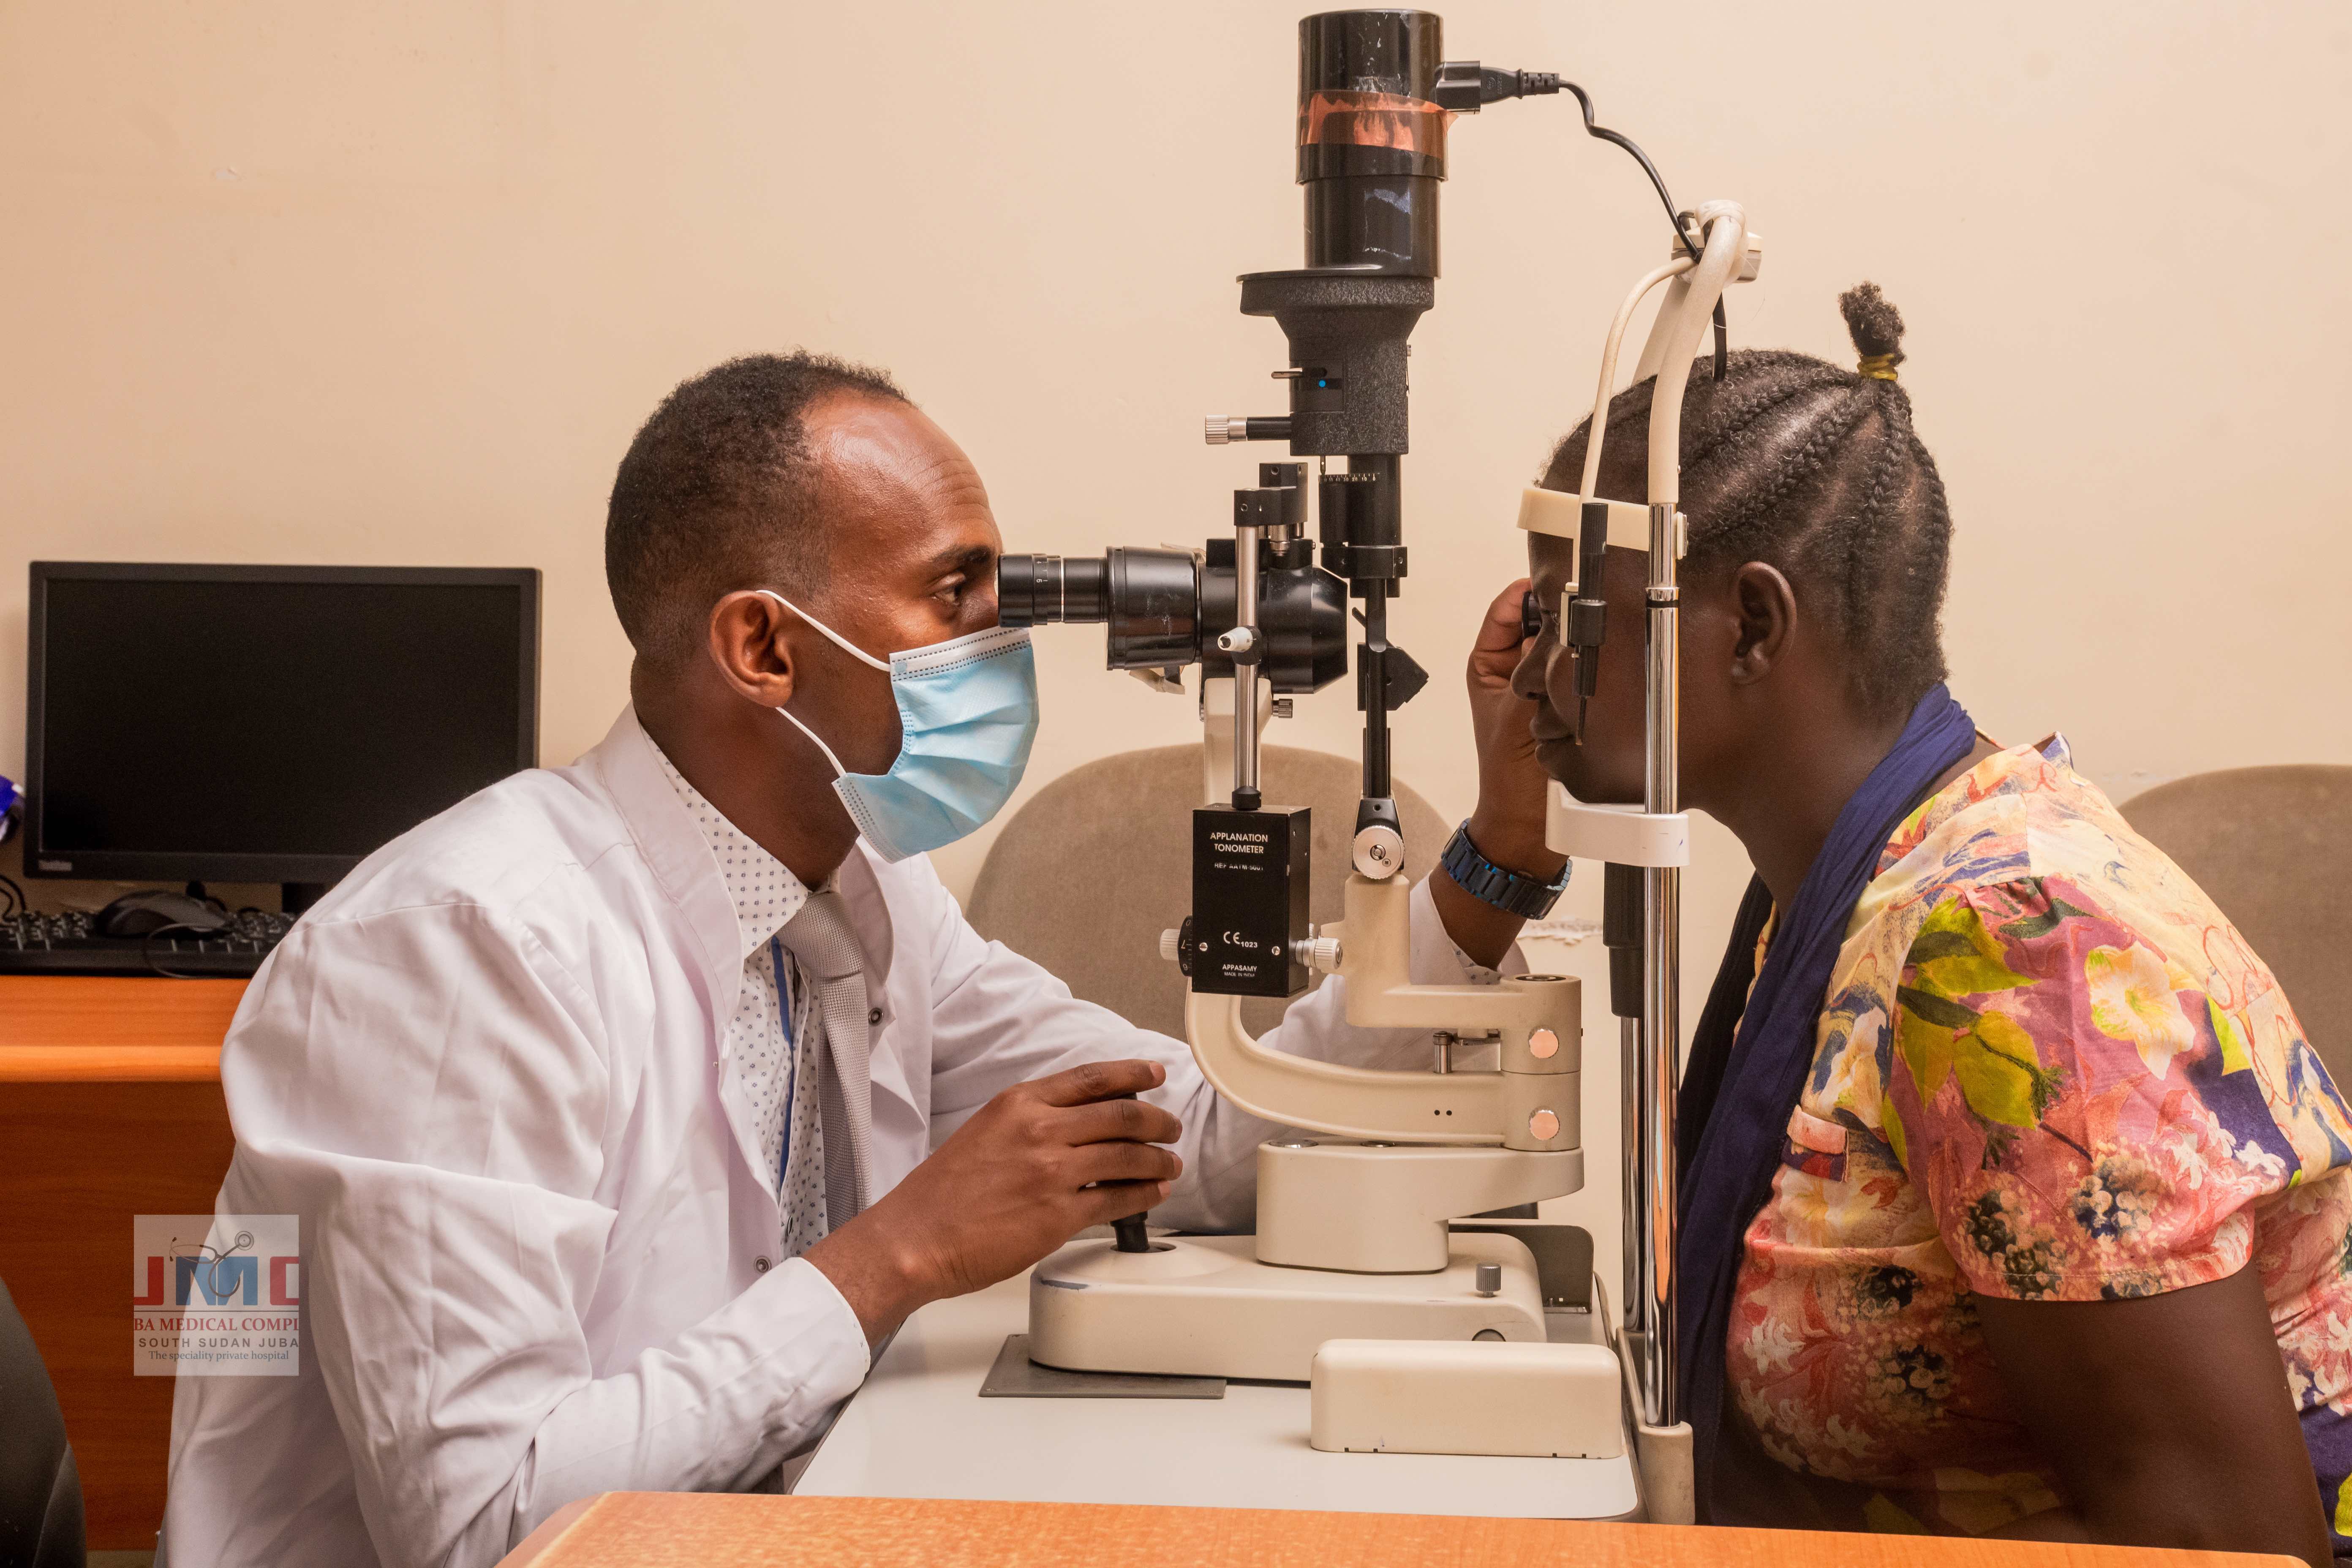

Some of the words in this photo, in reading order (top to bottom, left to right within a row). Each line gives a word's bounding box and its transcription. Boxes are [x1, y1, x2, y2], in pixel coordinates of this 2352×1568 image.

[1210, 832, 1268, 842] APPLANATION
[1214, 843, 1264, 854] TONOMETER
[1222, 964, 1258, 972] APPASAMY
